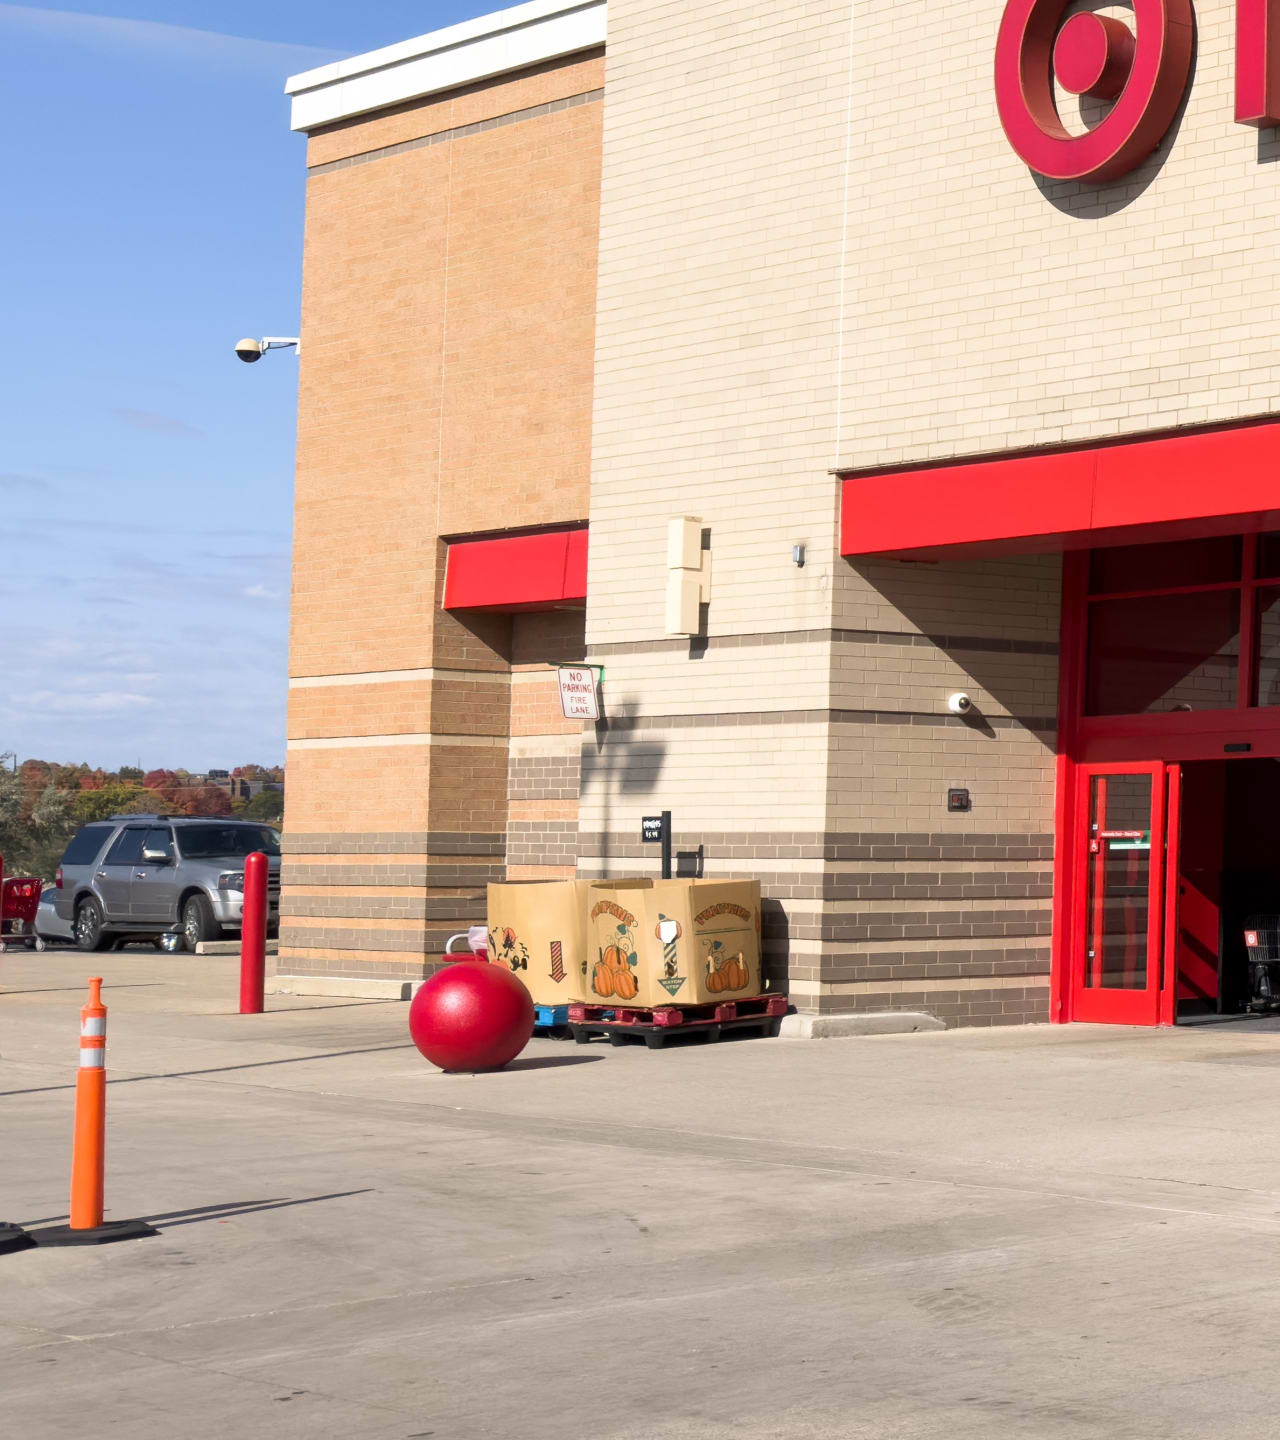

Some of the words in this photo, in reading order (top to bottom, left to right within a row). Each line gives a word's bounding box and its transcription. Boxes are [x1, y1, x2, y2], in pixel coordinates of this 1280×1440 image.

[570, 672, 582, 681] NO
[562, 683, 592, 693] PARKING
[570, 696, 587, 704] FIRE
[571, 706, 590, 714] LANE
